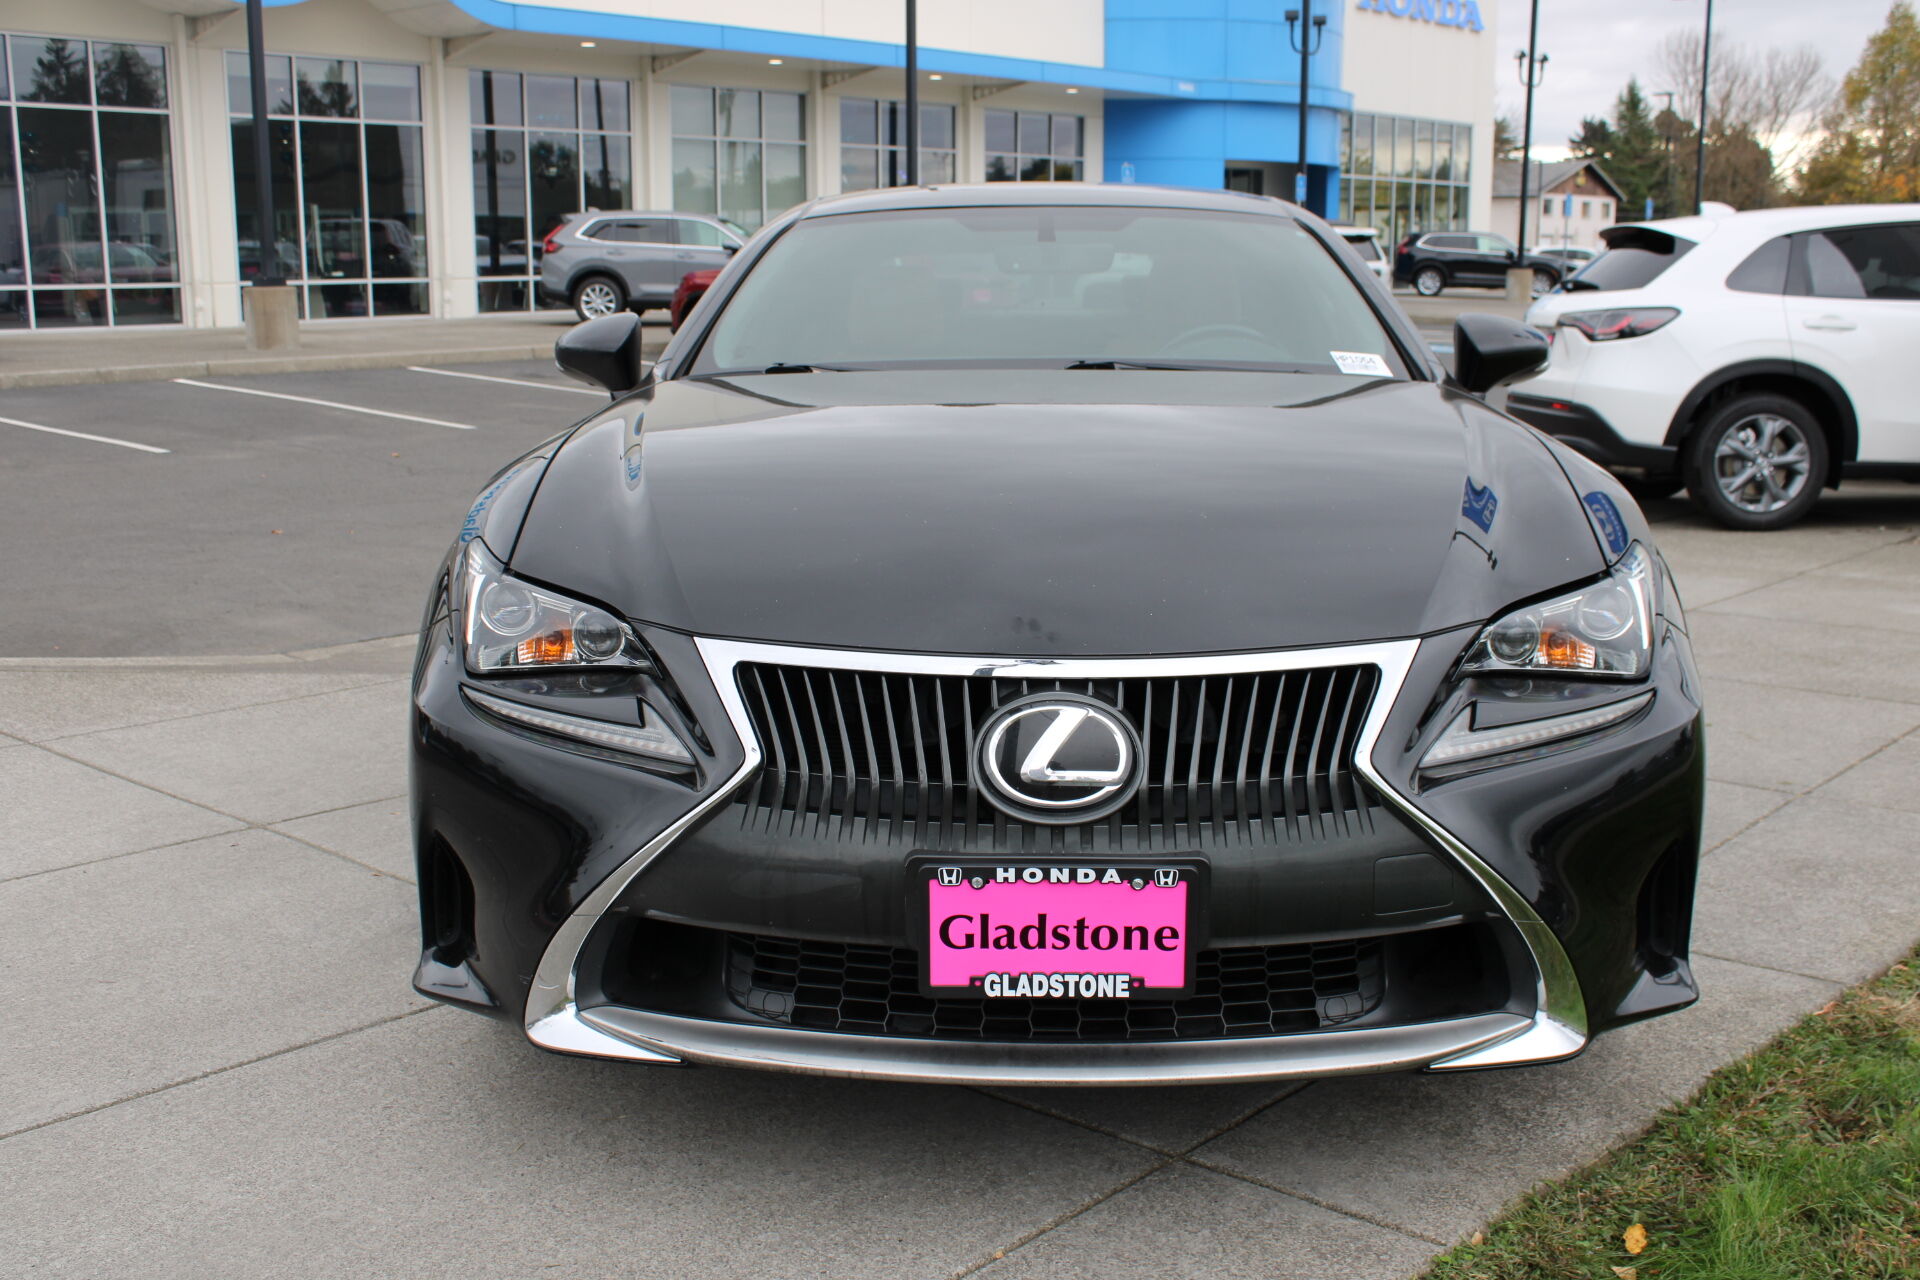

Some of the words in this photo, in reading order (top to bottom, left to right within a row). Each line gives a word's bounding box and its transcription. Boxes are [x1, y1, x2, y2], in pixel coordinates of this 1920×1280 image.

[995, 867, 1122, 884] HONDA
[939, 913, 1180, 951] Gladstone
[984, 973, 1130, 998] GLADSTONE
